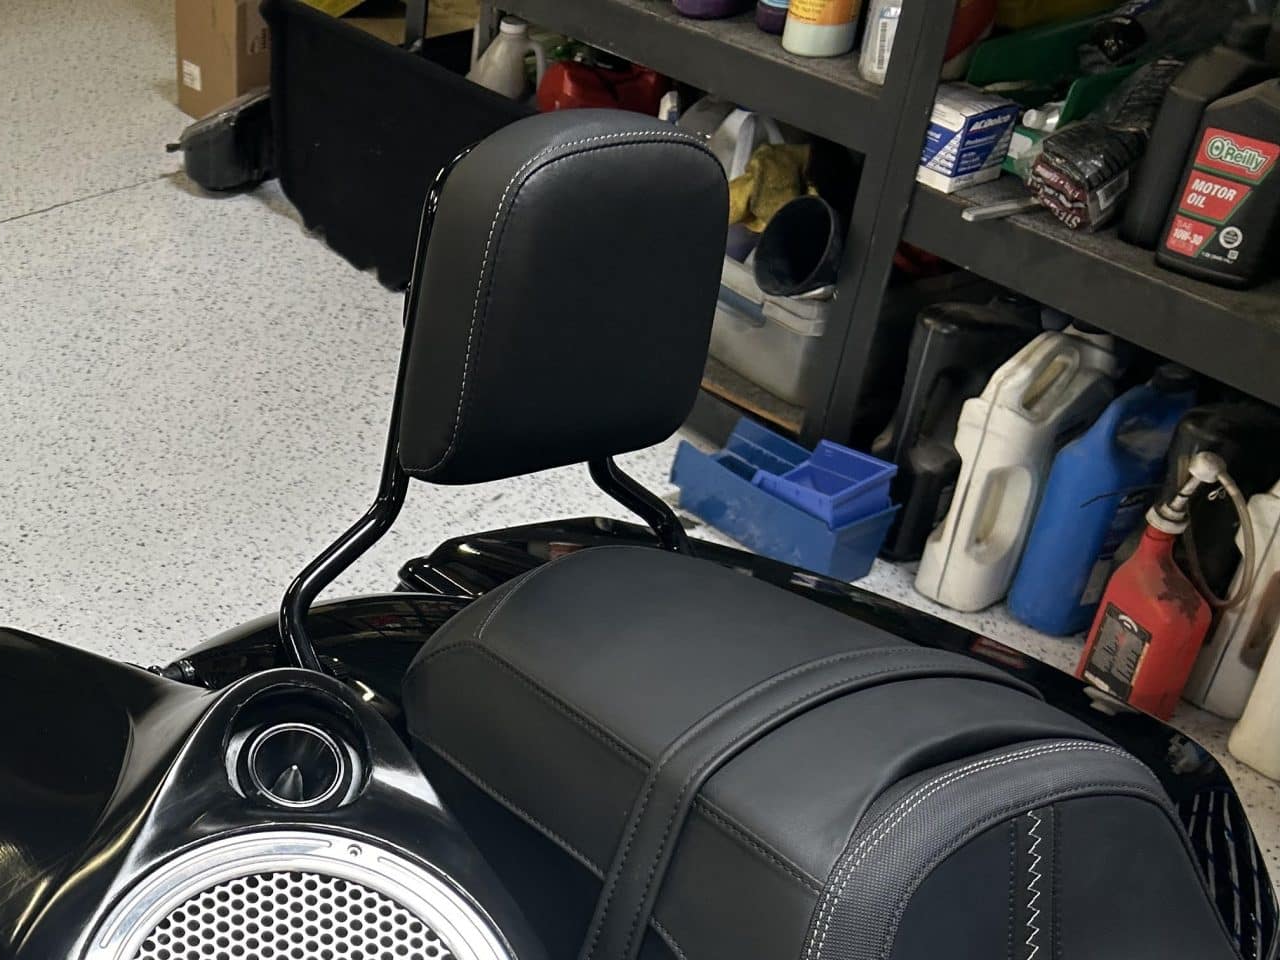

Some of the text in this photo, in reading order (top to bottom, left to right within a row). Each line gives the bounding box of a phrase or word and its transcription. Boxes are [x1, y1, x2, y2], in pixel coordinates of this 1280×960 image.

[1208, 137, 1269, 172] O'Reilly
[1186, 193, 1206, 208] OIL
[1191, 178, 1238, 201] MOTOR
